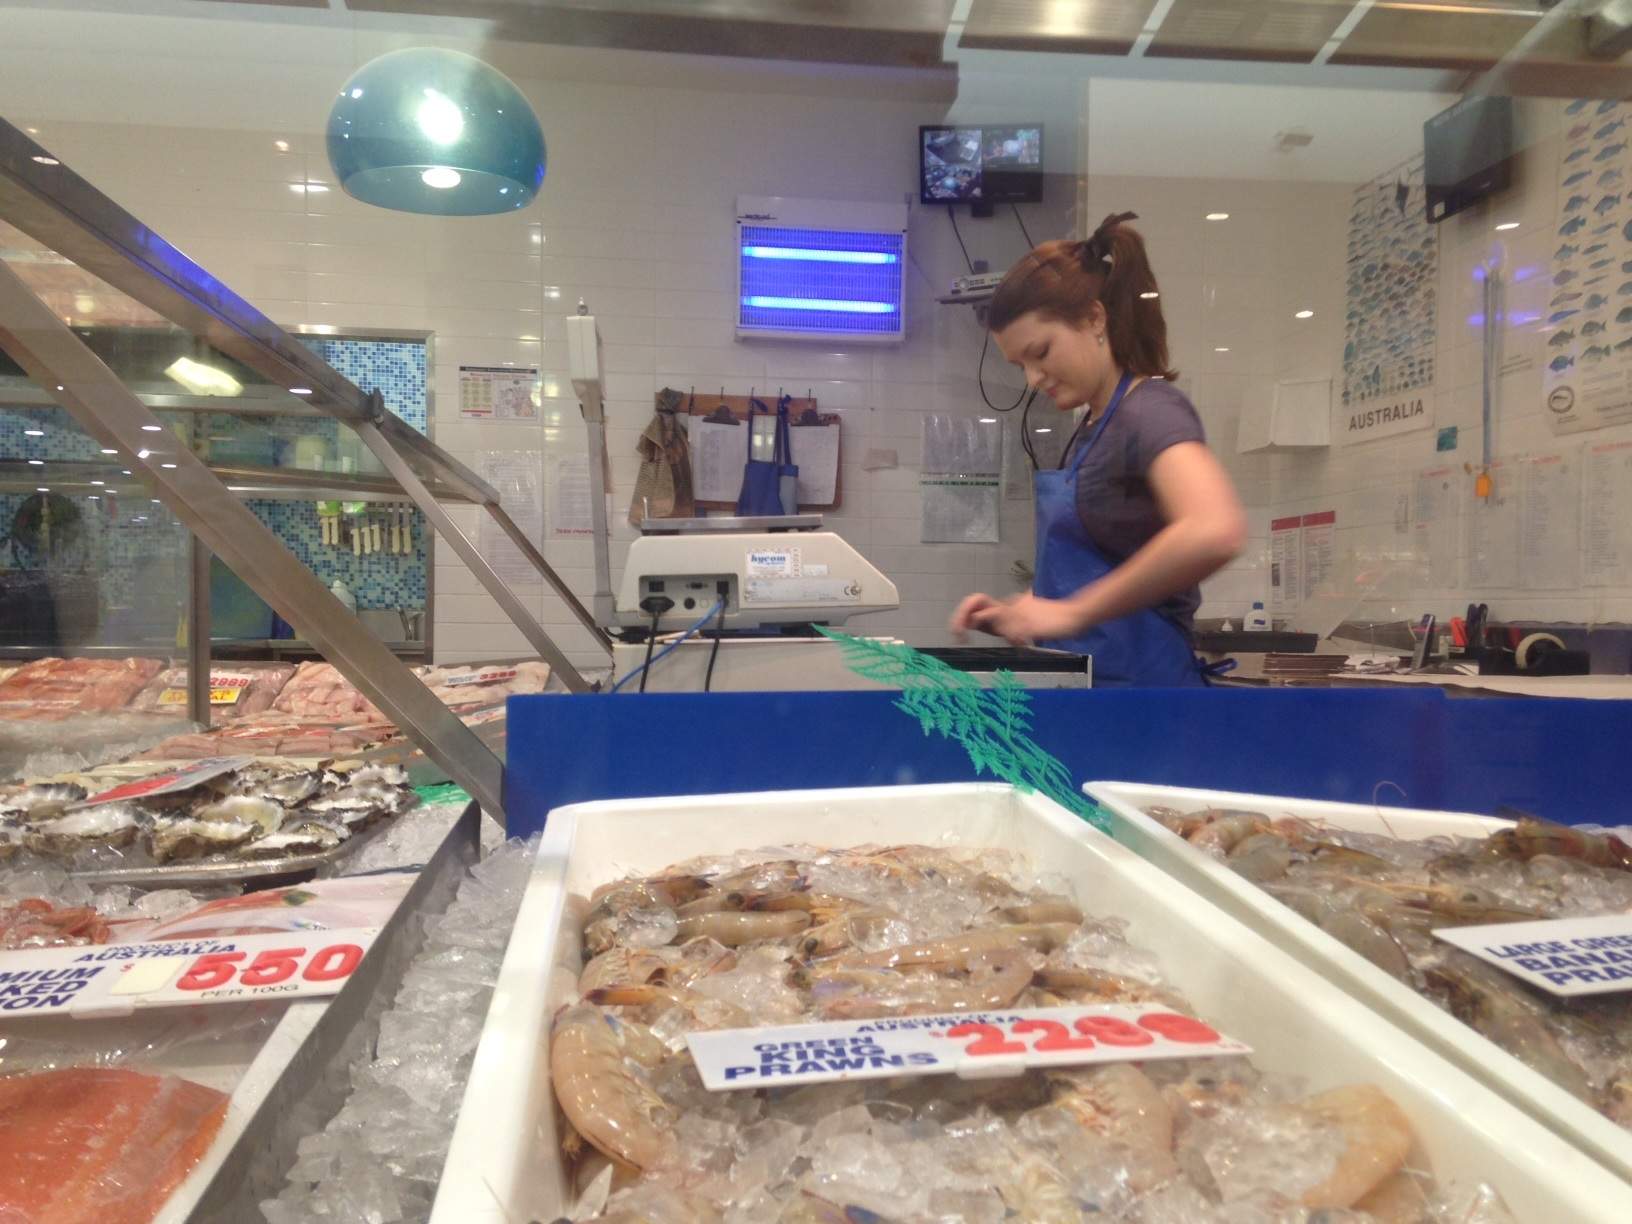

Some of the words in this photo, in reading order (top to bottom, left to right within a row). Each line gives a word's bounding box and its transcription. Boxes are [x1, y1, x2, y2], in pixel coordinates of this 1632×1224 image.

[1348, 399, 1424, 432] AUSTRALIA
[72, 943, 236, 963] AUSTRALIA
[1484, 941, 1575, 958] LARGE
[0, 994, 76, 1010] ON
[200, 988, 243, 999] PER
[753, 1036, 874, 1052] GREEN
[760, 1044, 886, 1064] KING
[724, 1052, 939, 1081] PRAWNS
